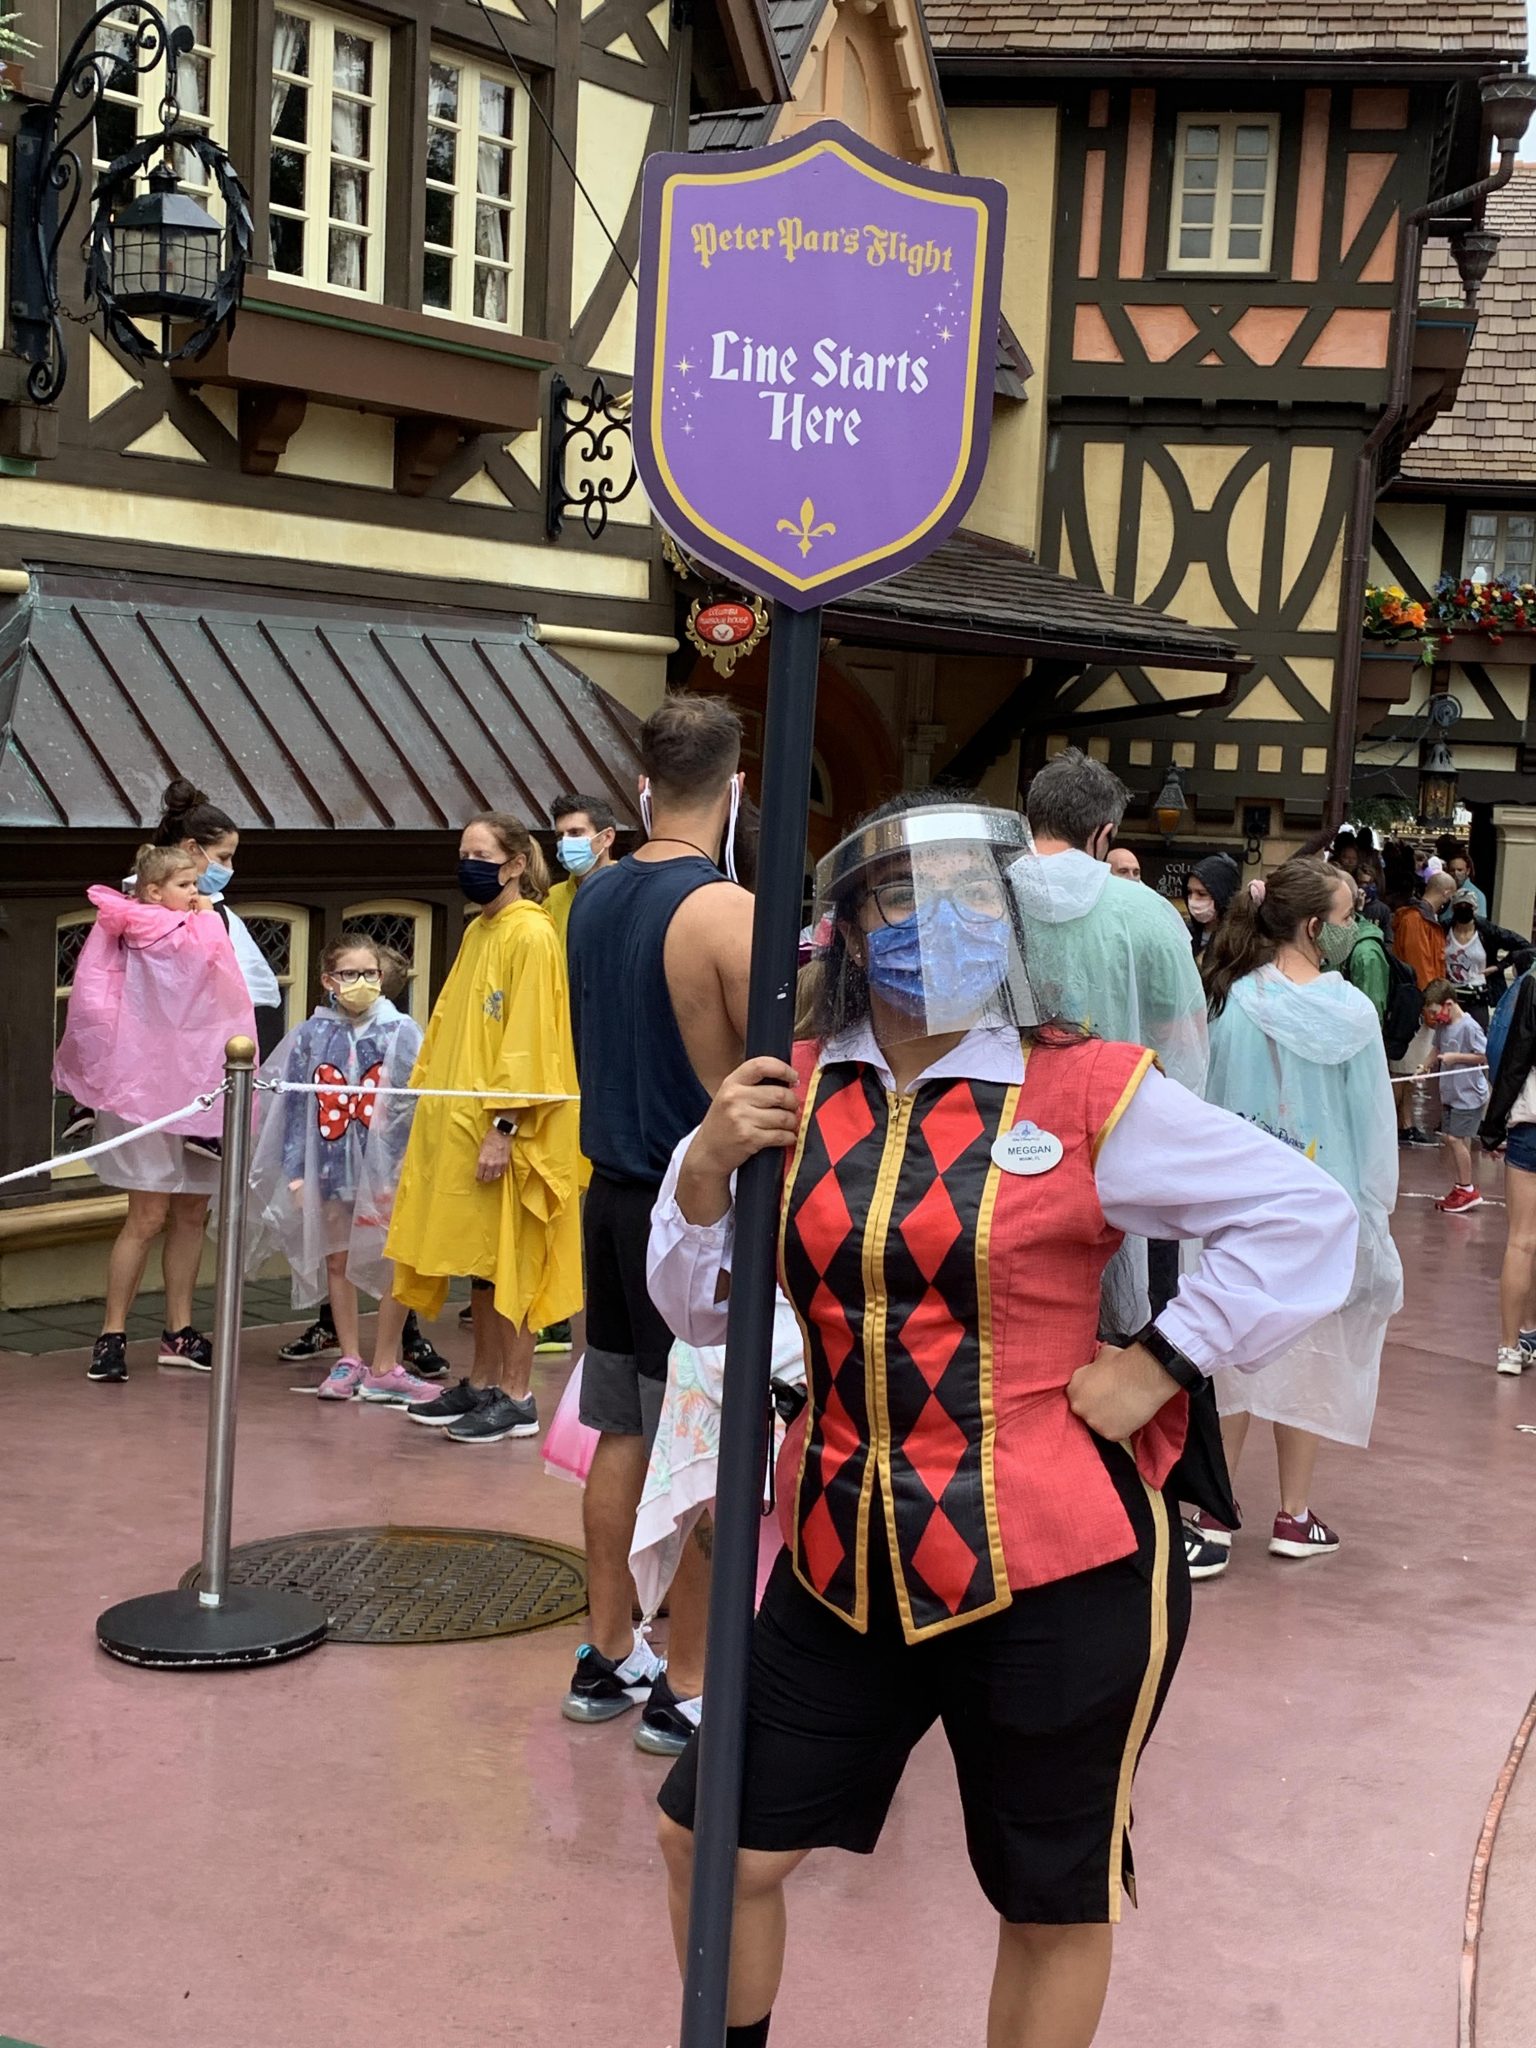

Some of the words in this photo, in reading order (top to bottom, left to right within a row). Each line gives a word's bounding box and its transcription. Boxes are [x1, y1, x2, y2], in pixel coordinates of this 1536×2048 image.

[691, 222, 775, 269] Peter
[777, 217, 860, 263] Pan's
[863, 224, 953, 277] Flight
[709, 330, 798, 385] Line
[811, 337, 929, 394] Starts
[758, 391, 862, 451] Here
[1007, 1145, 1052, 1155] MEGGAN
